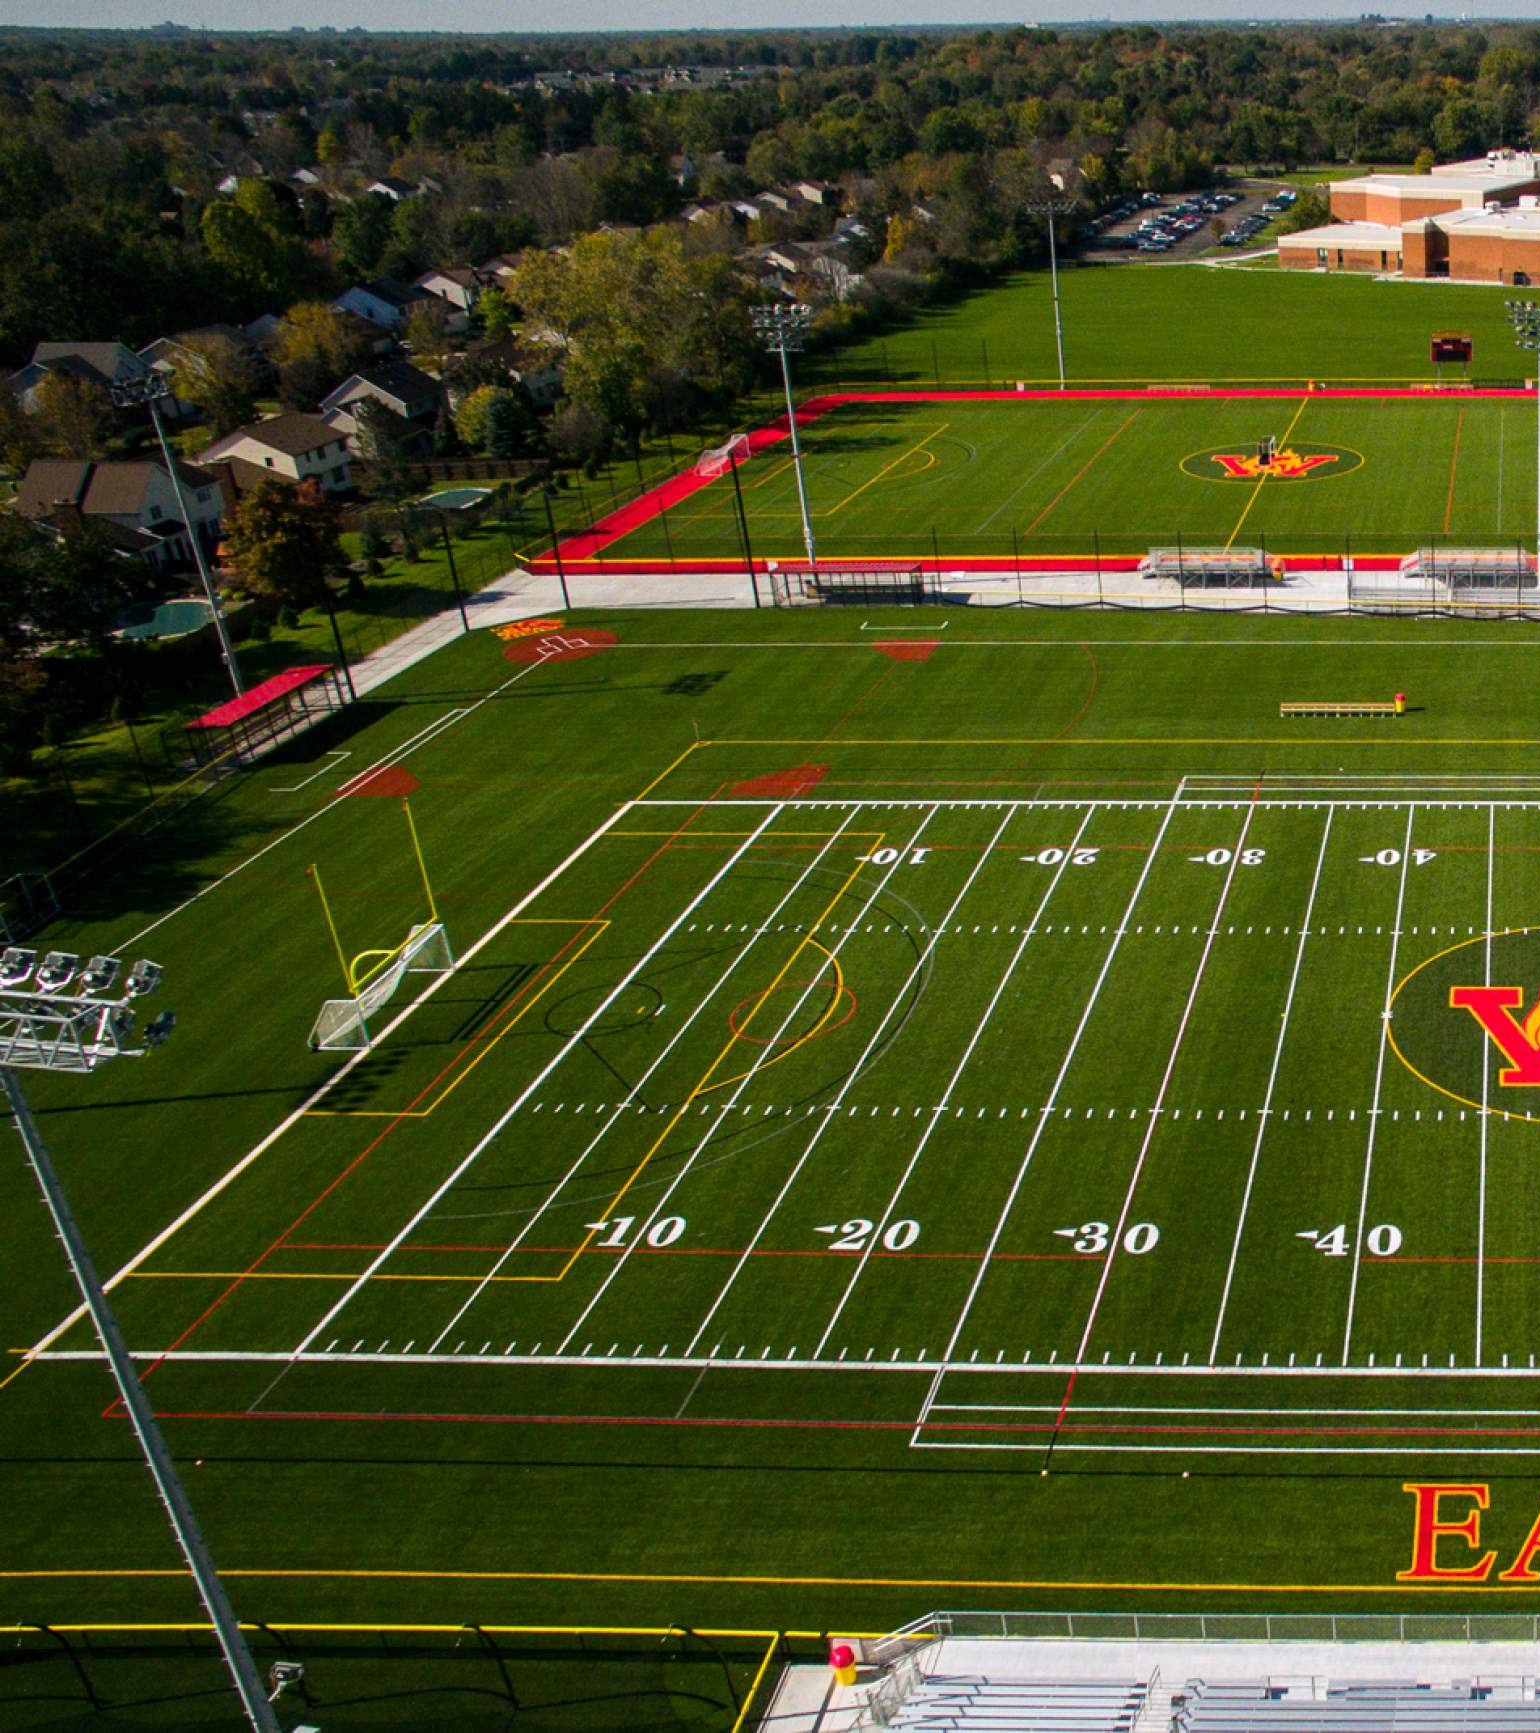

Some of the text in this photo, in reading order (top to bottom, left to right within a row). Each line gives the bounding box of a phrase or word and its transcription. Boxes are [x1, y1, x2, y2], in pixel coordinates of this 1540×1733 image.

[871, 848, 933, 865] 10
[1037, 848, 1101, 865] 20
[1206, 848, 1267, 865] 30
[1376, 849, 1437, 866] 40
[597, 1216, 687, 1248] 10
[828, 1219, 921, 1251] 20
[1073, 1221, 1161, 1254] 30
[1314, 1224, 1403, 1257] 40
